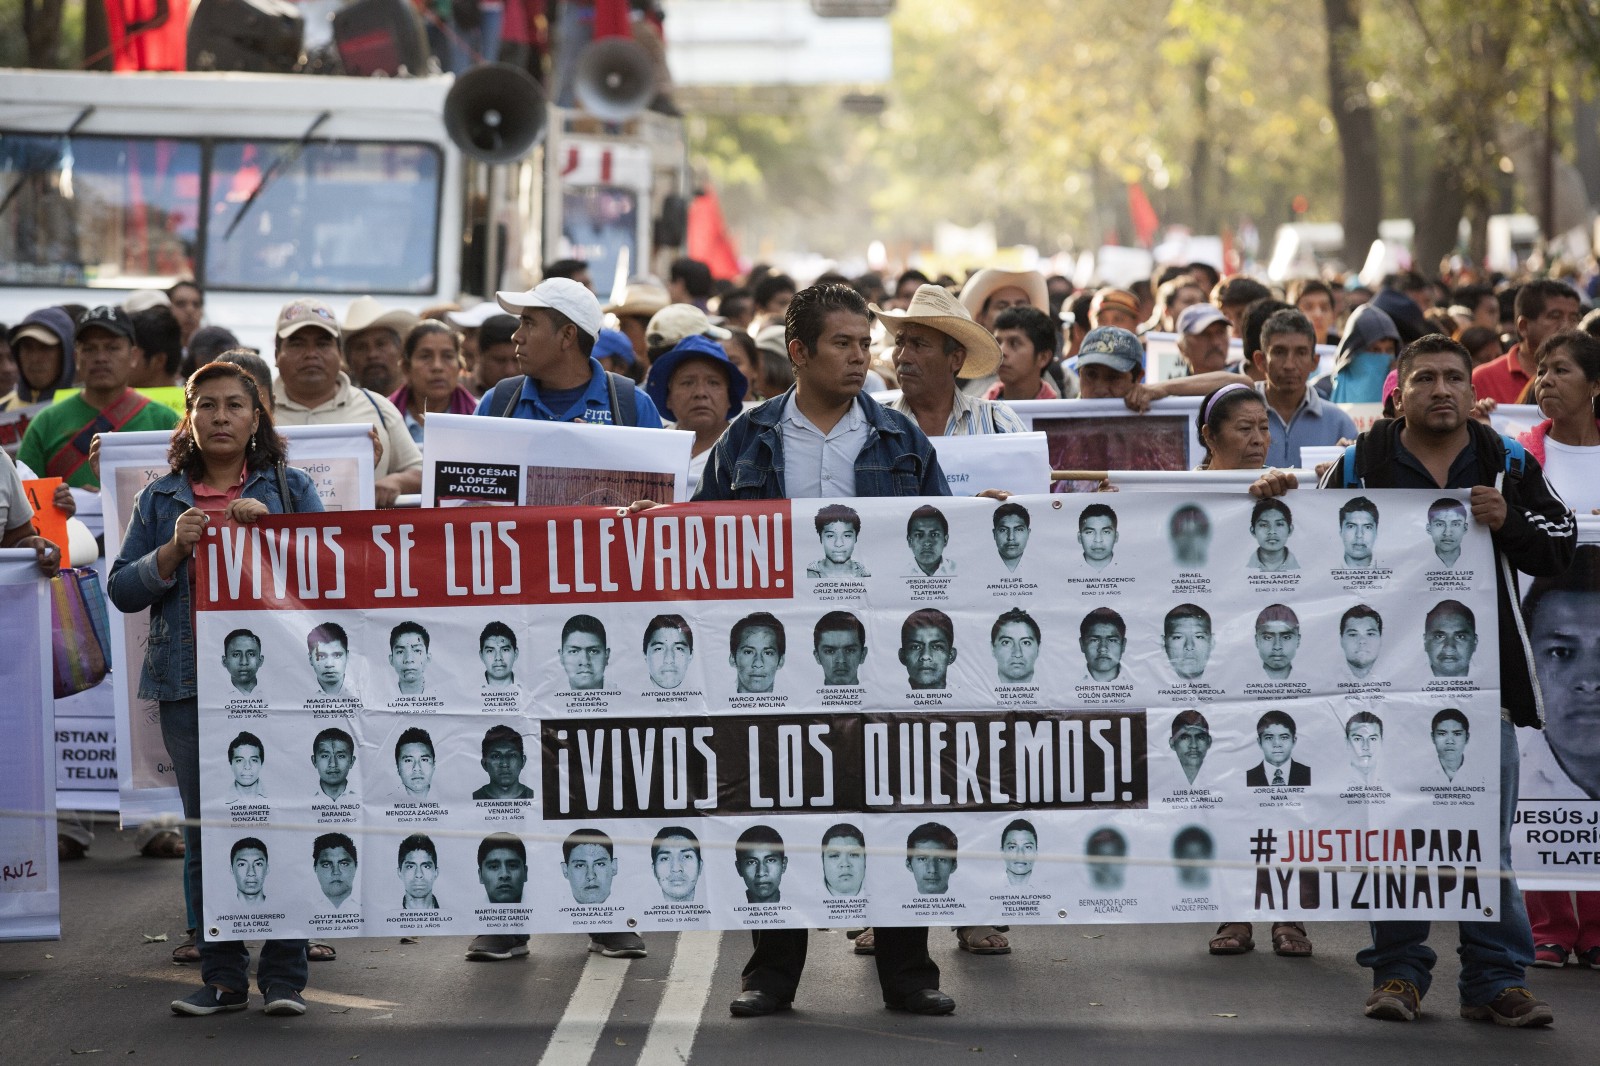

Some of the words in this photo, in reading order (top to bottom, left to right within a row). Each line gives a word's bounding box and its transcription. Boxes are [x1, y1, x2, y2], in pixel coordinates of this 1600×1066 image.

[441, 466, 476, 475] JULIO
[479, 466, 517, 477] CÉSAR
[460, 474, 497, 486] LÓPEZ
[449, 484, 506, 494] PATOLZIN
[208, 526, 345, 602] ¡VIVOS
[374, 524, 418, 598] SE
[445, 520, 520, 596] LOS
[548, 513, 786, 594] LLEVARON!
[55, 731, 108, 742] ISTIAN
[62, 747, 116, 761] RODRÍ
[558, 726, 717, 813] ¡VIVOS
[749, 724, 834, 808] LOS
[865, 718, 1132, 807] QUEREMOS!
[1513, 808, 1582, 824] JESÚS
[1526, 827, 1598, 844] RODRÍ
[2, 860, 38, 879] RUZ
[1254, 865, 1482, 910] AYOTZINAPA
